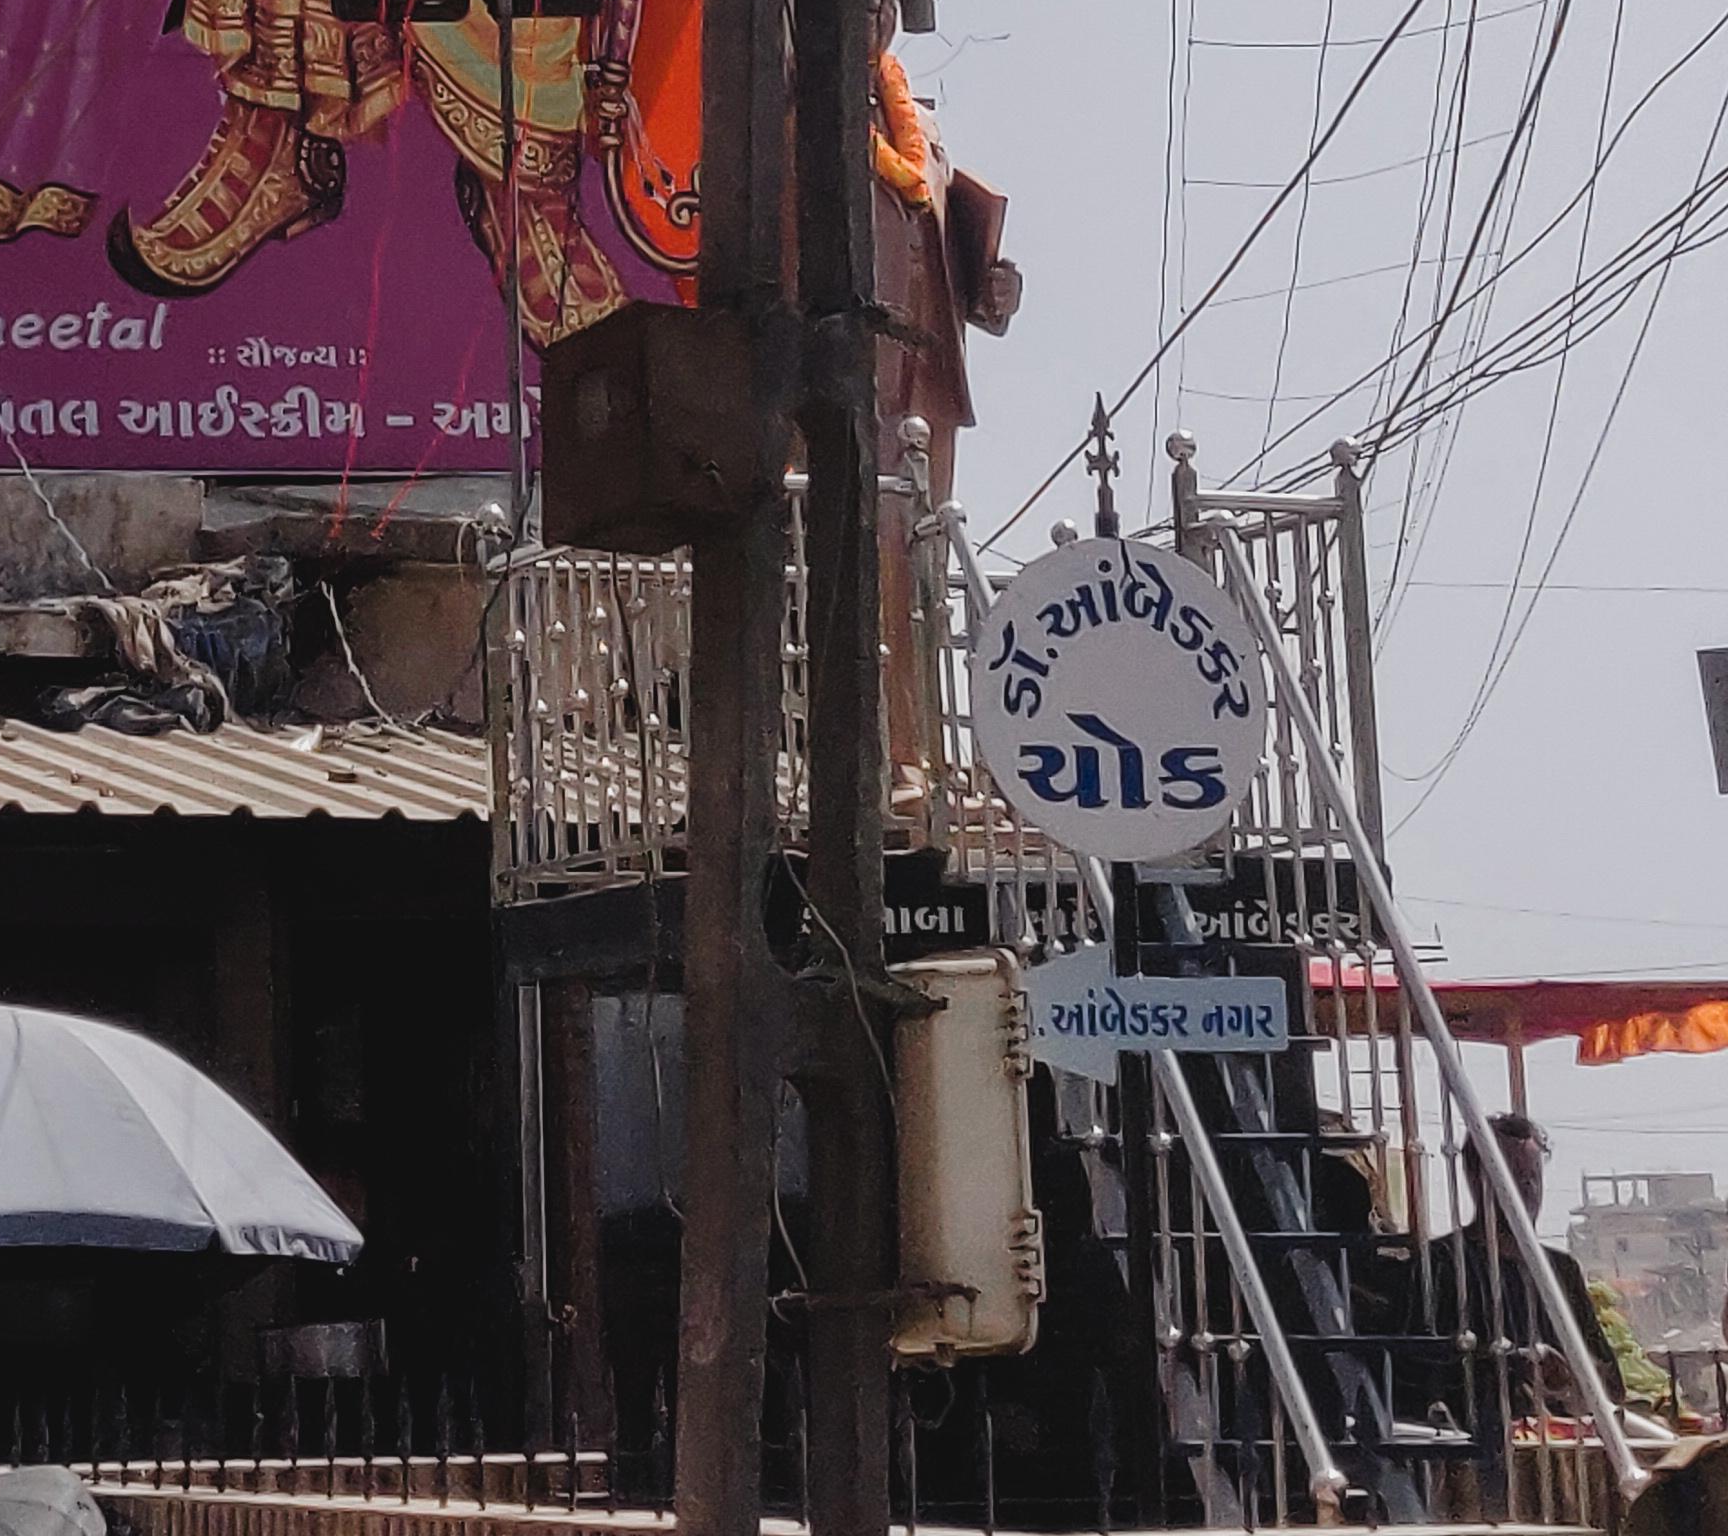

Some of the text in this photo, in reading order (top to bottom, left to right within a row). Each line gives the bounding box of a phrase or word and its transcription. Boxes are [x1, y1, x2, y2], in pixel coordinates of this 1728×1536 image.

[1036, 558, 1250, 721] આંબેડકર
[1016, 711, 1228, 810] ચોક
[1051, 984, 1190, 1040] આંબેડકર
[1201, 1003, 1275, 1040] નગર
